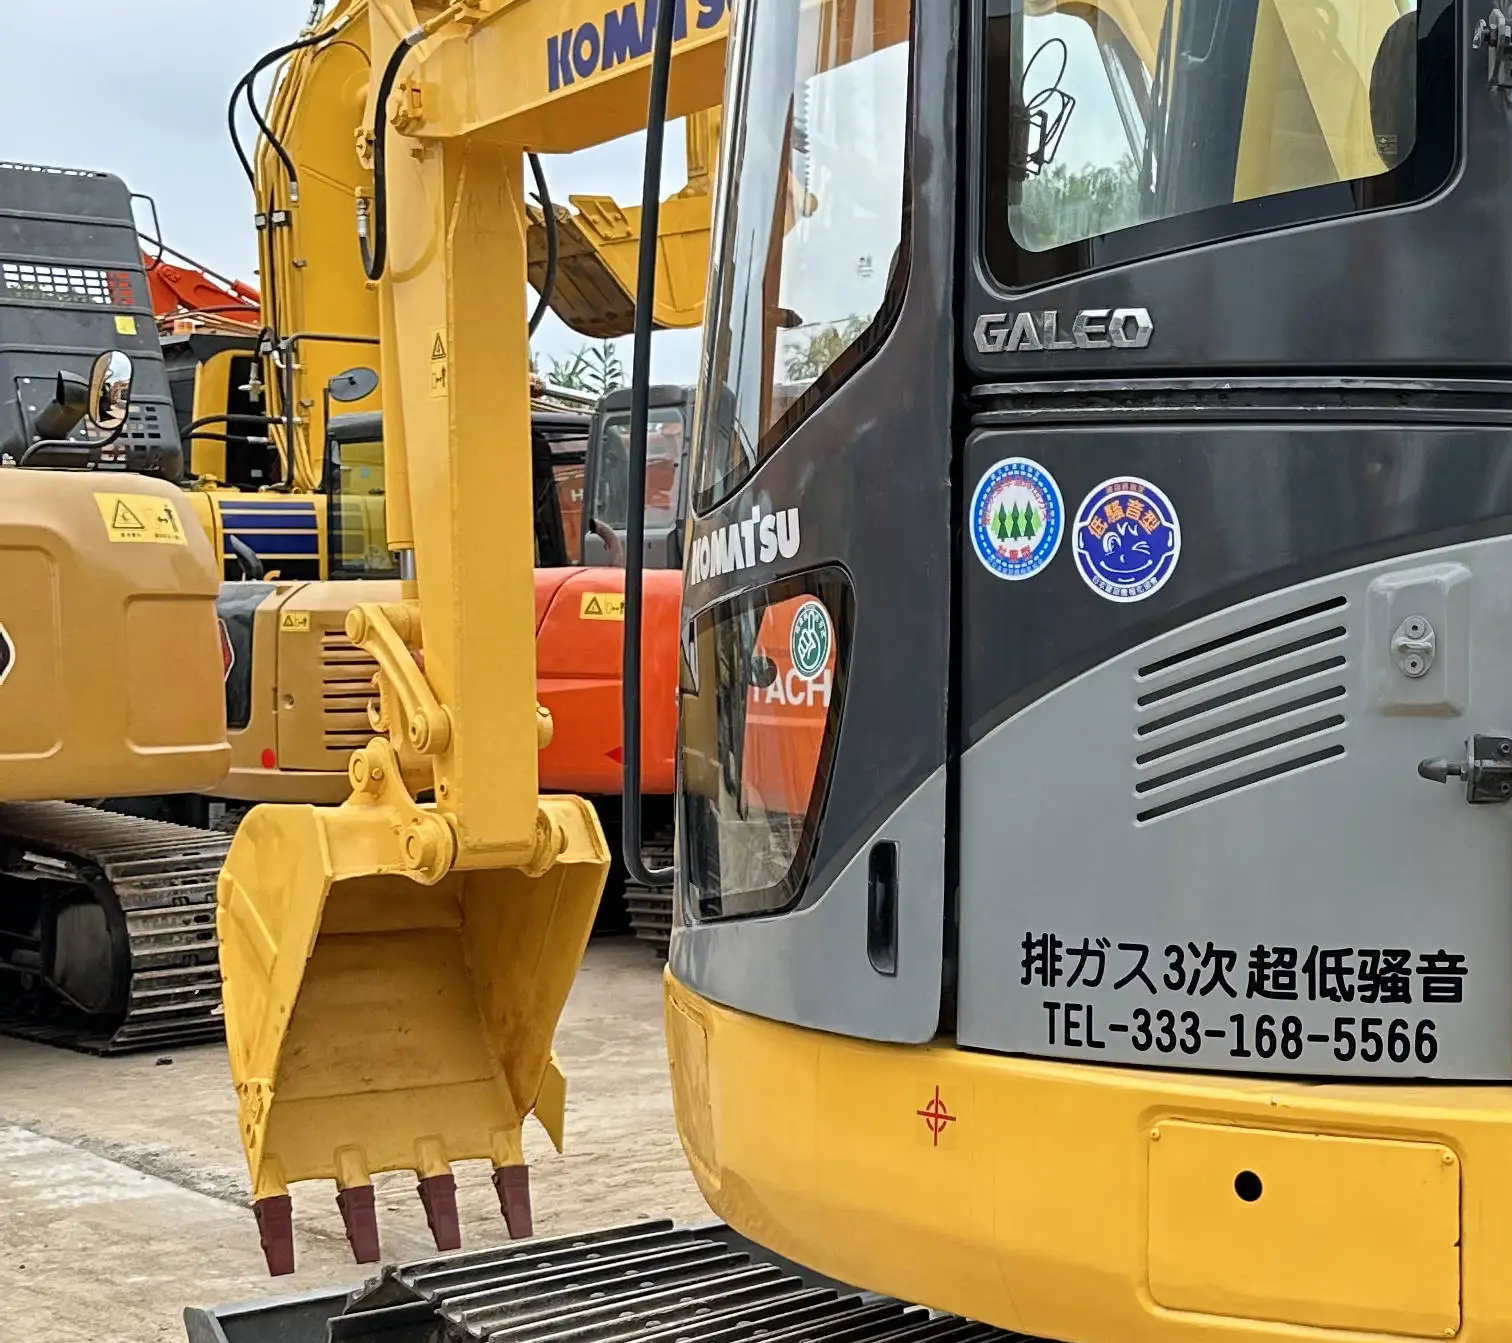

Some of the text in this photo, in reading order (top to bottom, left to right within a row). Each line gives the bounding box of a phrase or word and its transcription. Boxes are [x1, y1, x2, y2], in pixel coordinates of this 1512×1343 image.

[973, 308, 1153, 353] GALEO
[691, 505, 800, 585] KOMATSU
[1043, 1001, 1438, 1063] TEL-333-168-5566
